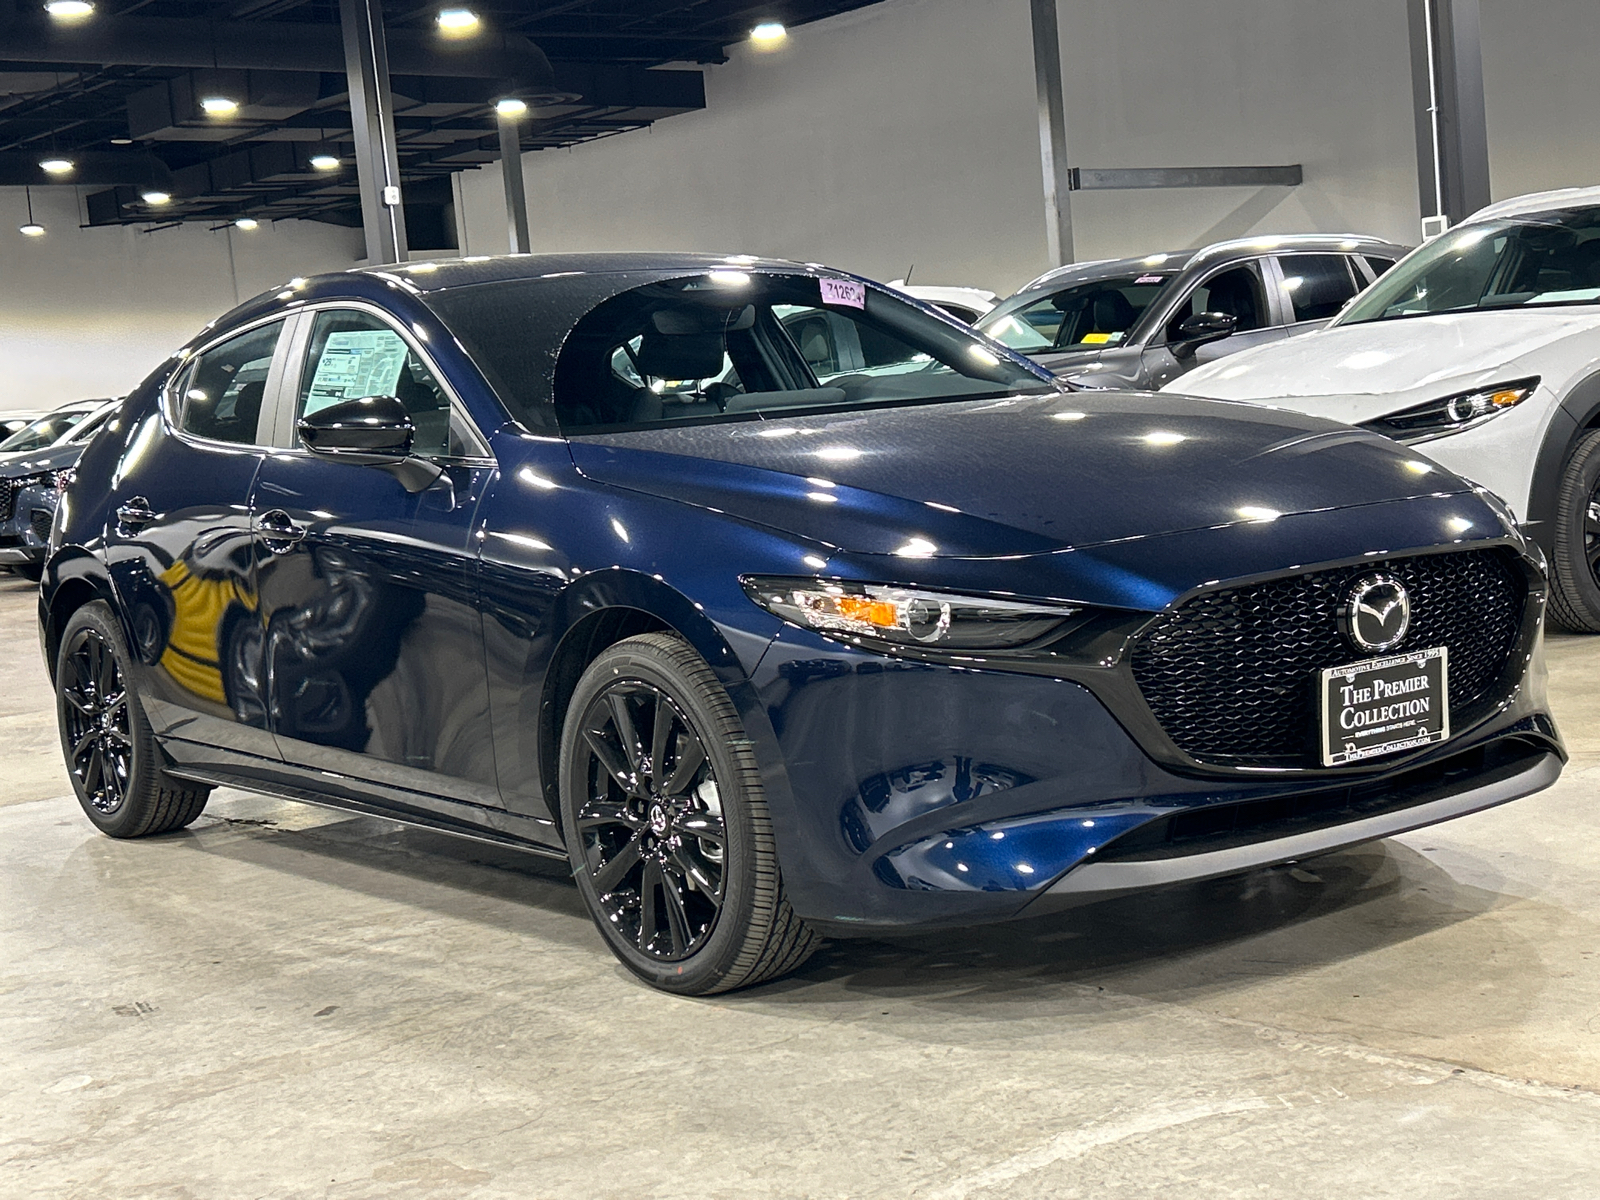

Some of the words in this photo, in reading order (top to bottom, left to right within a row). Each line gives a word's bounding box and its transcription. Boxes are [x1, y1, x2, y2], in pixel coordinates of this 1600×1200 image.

[1340, 685, 1371, 706] THE
[1373, 675, 1429, 700] PREMIER
[1340, 697, 1430, 729] COLLECTION
